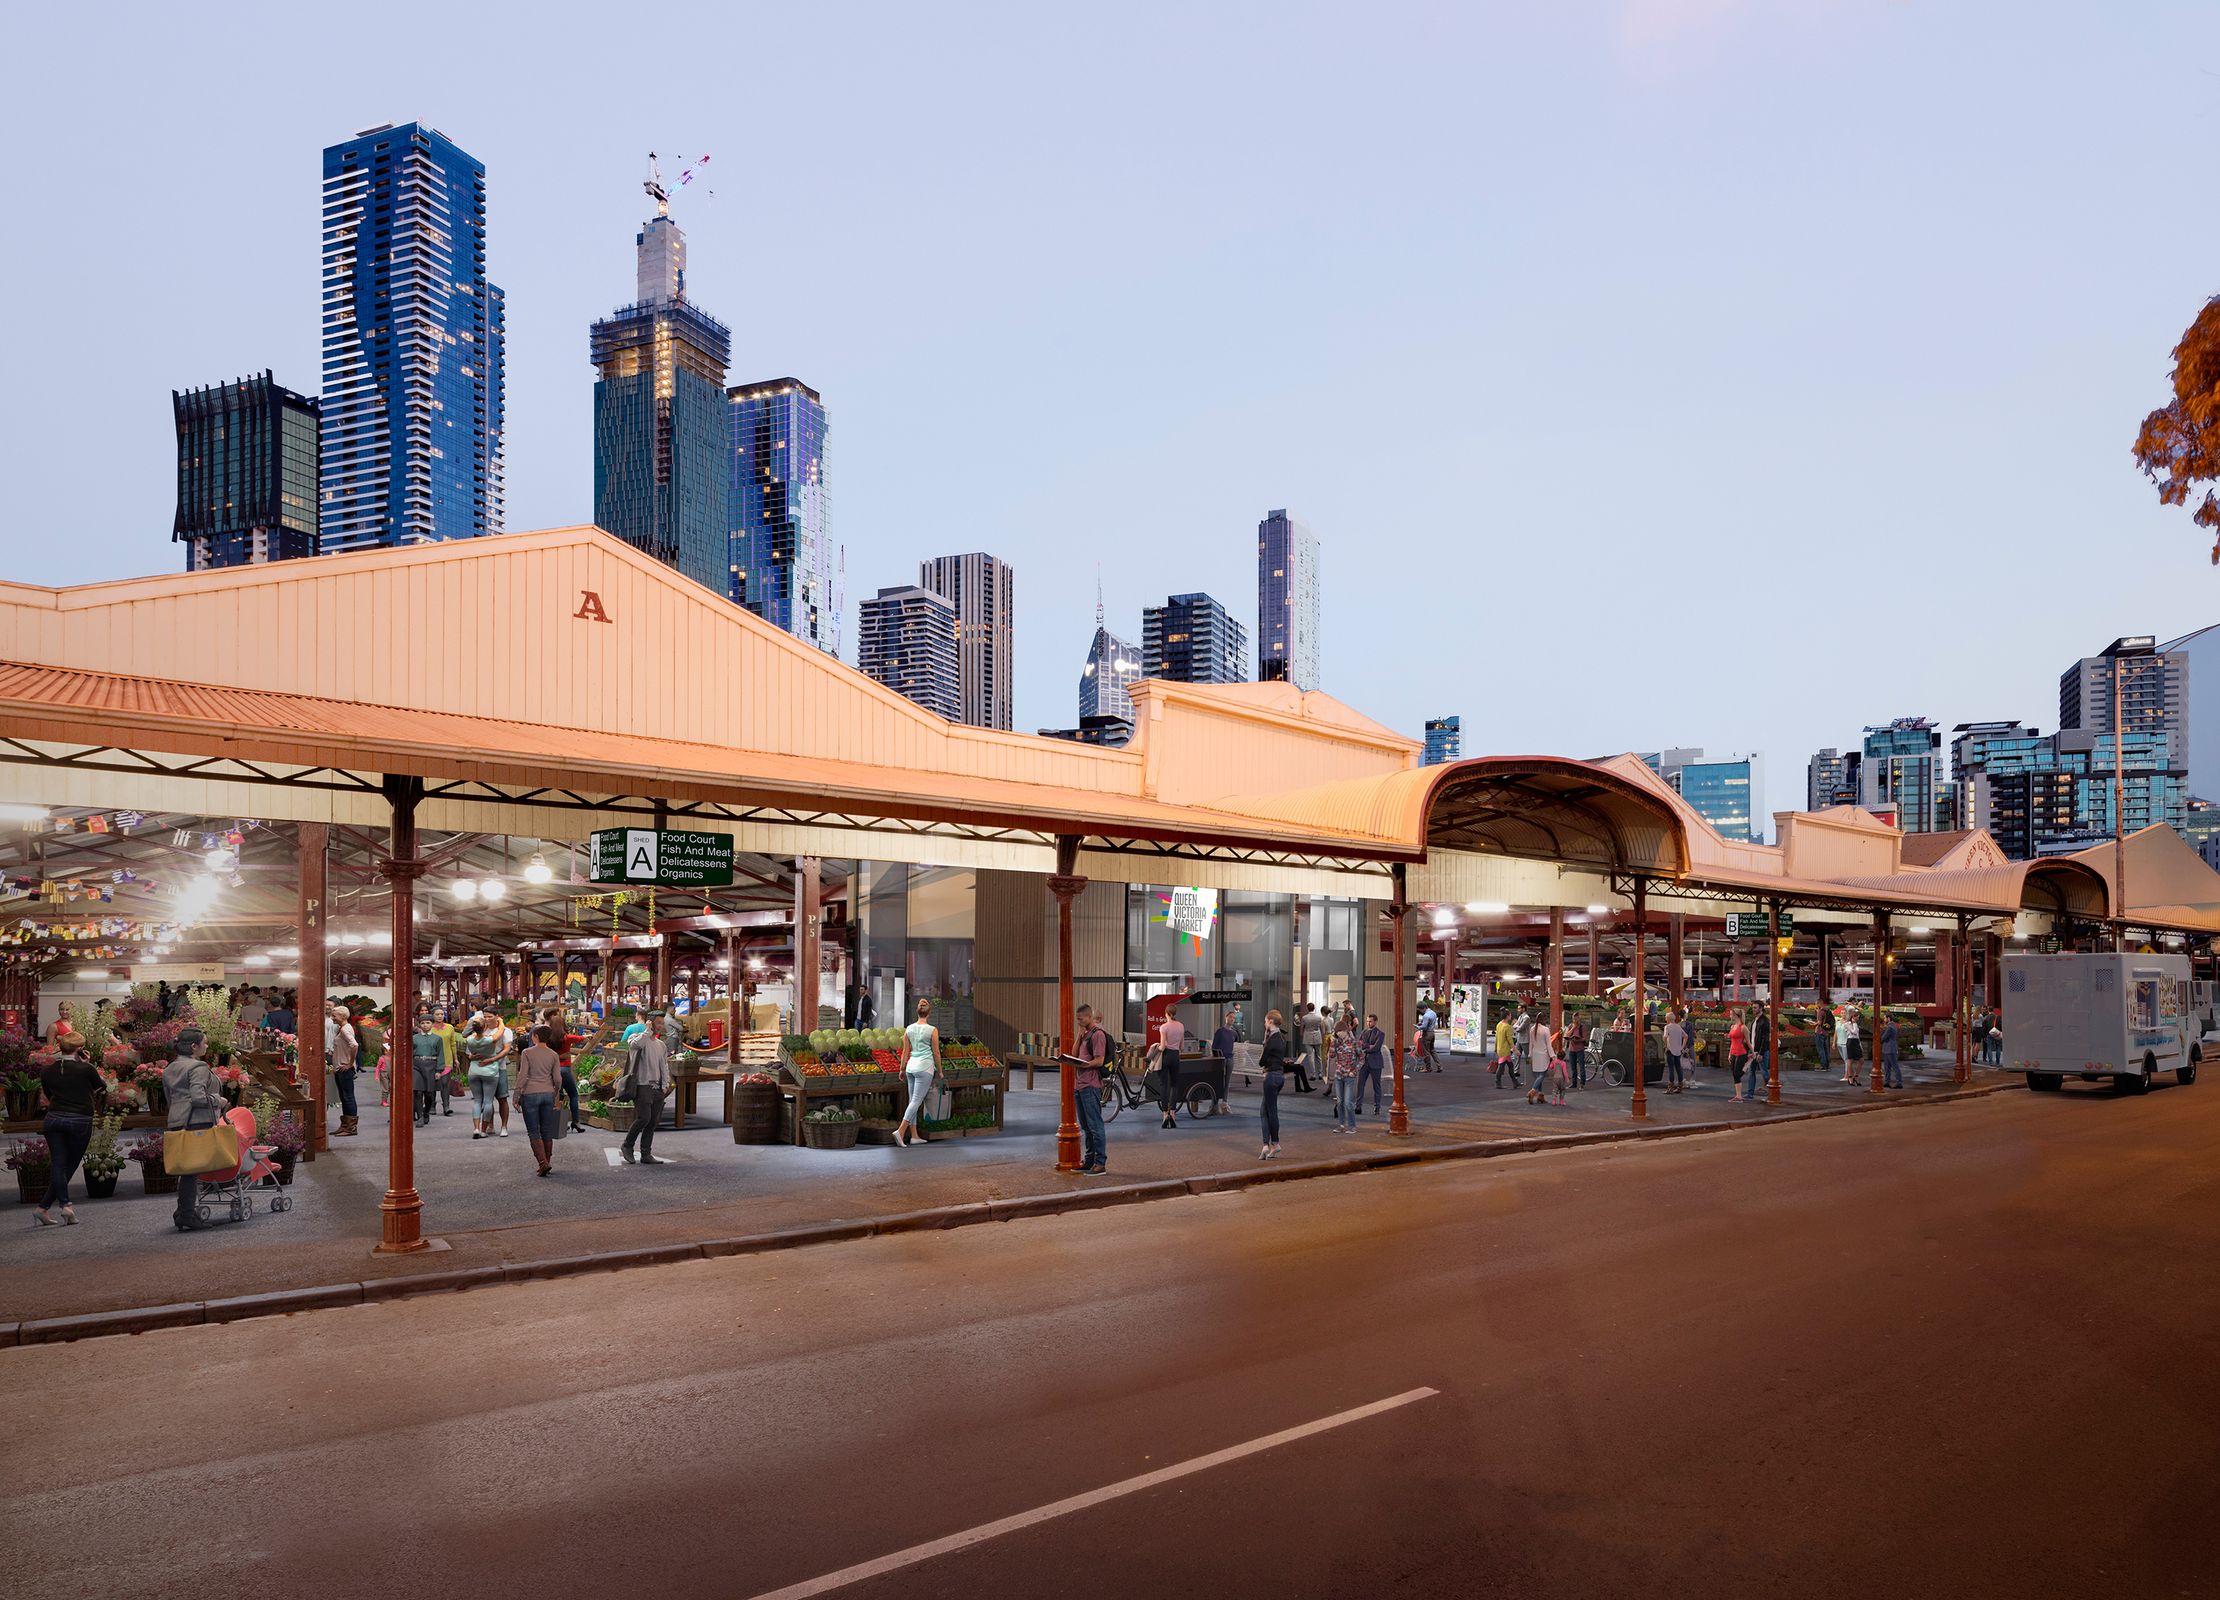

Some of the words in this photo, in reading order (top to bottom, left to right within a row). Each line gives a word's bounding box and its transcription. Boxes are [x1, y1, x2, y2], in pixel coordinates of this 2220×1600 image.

[573, 590, 613, 624] A
[600, 832, 610, 842] Food
[610, 831, 620, 841] Court
[660, 832, 686, 842] Food
[689, 834, 716, 845] Court
[600, 844, 608, 854] Fish
[616, 843, 625, 852] Meat
[660, 844, 681, 854] Fish
[684, 846, 704, 856] And
[707, 847, 731, 857] Meat
[591, 849, 599, 873] A
[600, 856, 624, 866] Delicatessens
[630, 846, 653, 872] A
[660, 856, 727, 868] Delicatessens
[1979, 858, 1983, 867] C
[600, 868, 615, 879] Organics
[660, 868, 704, 880] Organics
[306, 899, 319, 911] P
[1174, 892, 1198, 906] QUEEN
[1174, 905, 1207, 920] VICTORIA
[307, 915, 316, 927] 4
[808, 915, 816, 924] P
[1173, 918, 1203, 932] MARKET
[1729, 921, 1736, 932] B
[810, 929, 815, 937] 5
